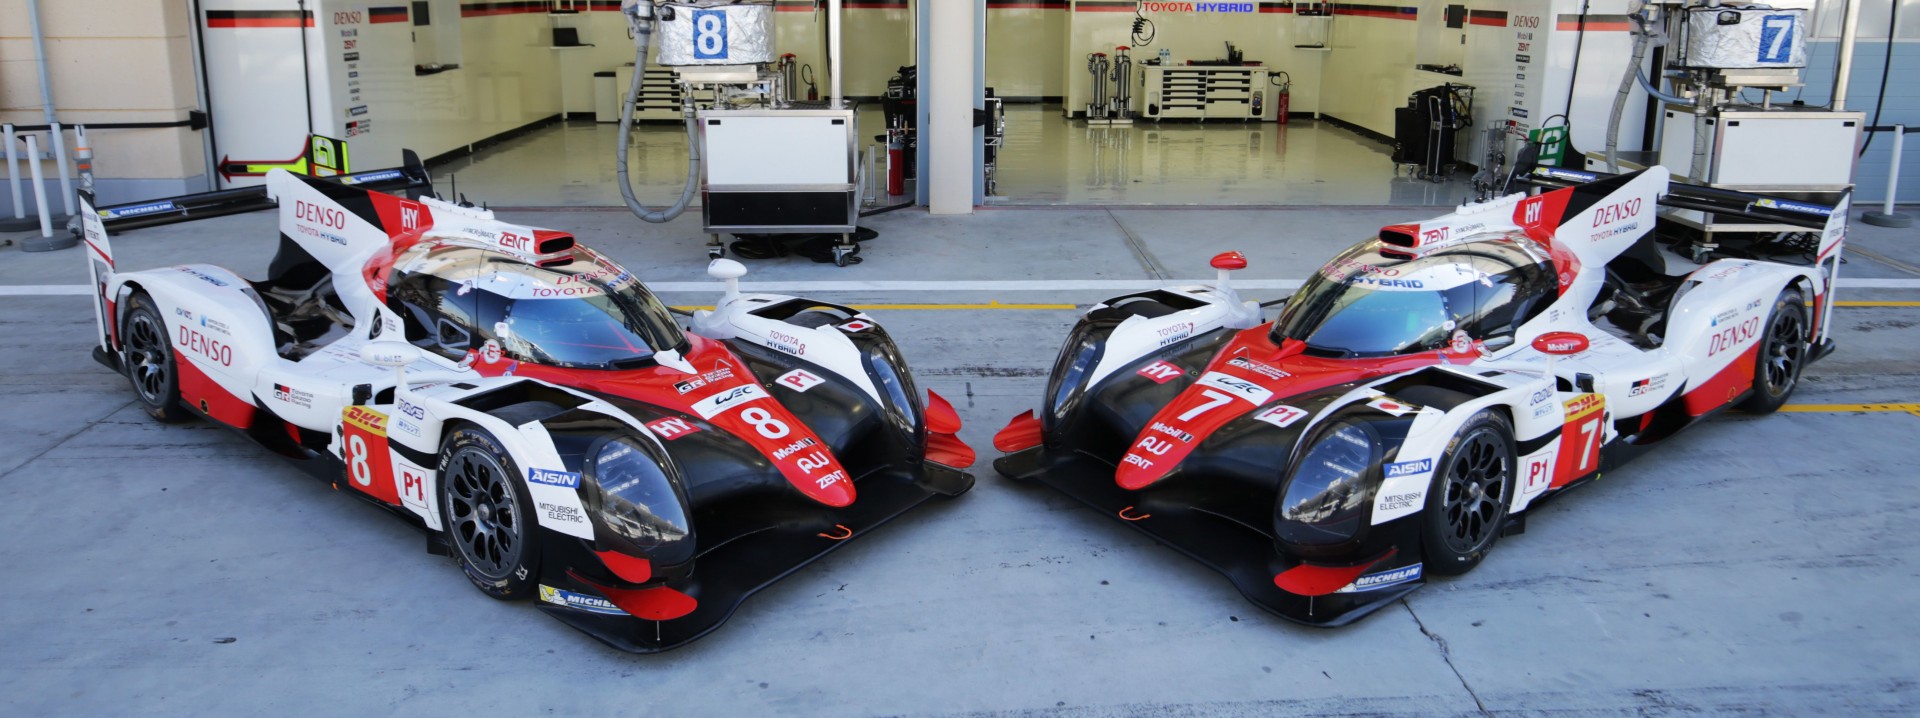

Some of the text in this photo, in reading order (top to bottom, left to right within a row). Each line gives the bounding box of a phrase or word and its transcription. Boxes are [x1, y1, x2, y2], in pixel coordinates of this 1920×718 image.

[1143, 3, 1253, 13] TOYOTA HYBRID
[334, 11, 361, 25] DENSO
[1513, 15, 1540, 29] DENSO
[697, 14, 724, 55] 8
[1766, 19, 1791, 60] 7
[359, 172, 400, 182] MICHELIN
[119, 202, 172, 216] MICHELIN
[295, 200, 345, 230] DENSO
[401, 206, 418, 230] HY
[1525, 201, 1542, 224] HY
[1592, 197, 1642, 228] DENSO
[297, 223, 348, 246] TOYOTA HYBRID
[499, 231, 531, 252] ZENT
[1422, 226, 1450, 246] ZENT
[1590, 222, 1639, 242] TOYOTA HYBRID
[556, 266, 617, 286] DENSO
[1352, 275, 1425, 290] HYBRID
[532, 286, 600, 298] TOYOTA
[1157, 321, 1194, 337] TOYOTA 7
[1160, 331, 1189, 346] HYBRID
[1707, 316, 1760, 358] DENSO
[179, 324, 232, 367] DENSO
[766, 339, 797, 355] HYBRID
[769, 330, 806, 356] TOYOTA 8
[1547, 342, 1570, 351] Mobil
[784, 369, 819, 388] P1
[1142, 361, 1181, 379] HY
[677, 378, 706, 394] GR
[715, 385, 752, 405] WEC
[1216, 377, 1263, 394] WEC
[1630, 387, 1648, 396] GR
[274, 390, 290, 402] GR
[1177, 389, 1234, 422] 7
[1567, 393, 1600, 416] DHL
[348, 406, 383, 430] DHL
[398, 398, 425, 420] RAYS
[1263, 406, 1299, 423] P1
[650, 418, 687, 438] HY
[740, 407, 790, 439] 8
[1151, 421, 1183, 440] Mobil
[772, 441, 806, 460] Mobil
[1579, 416, 1600, 471] 7
[350, 433, 371, 487] 8
[1123, 452, 1154, 470] ZENT
[1388, 460, 1430, 476] AISIN
[531, 471, 577, 486] AISIN
[815, 469, 845, 489] ZENT
[1529, 458, 1549, 487] P1
[403, 470, 424, 500] P1
[1379, 500, 1413, 511] ELECTRIC
[1384, 491, 1422, 504] MITSUBISHI
[538, 502, 578, 516] MITSUBISHI
[548, 511, 584, 524] ELECTRIC
[1356, 563, 1420, 586] MICHELIN
[567, 594, 618, 608] MICHE
